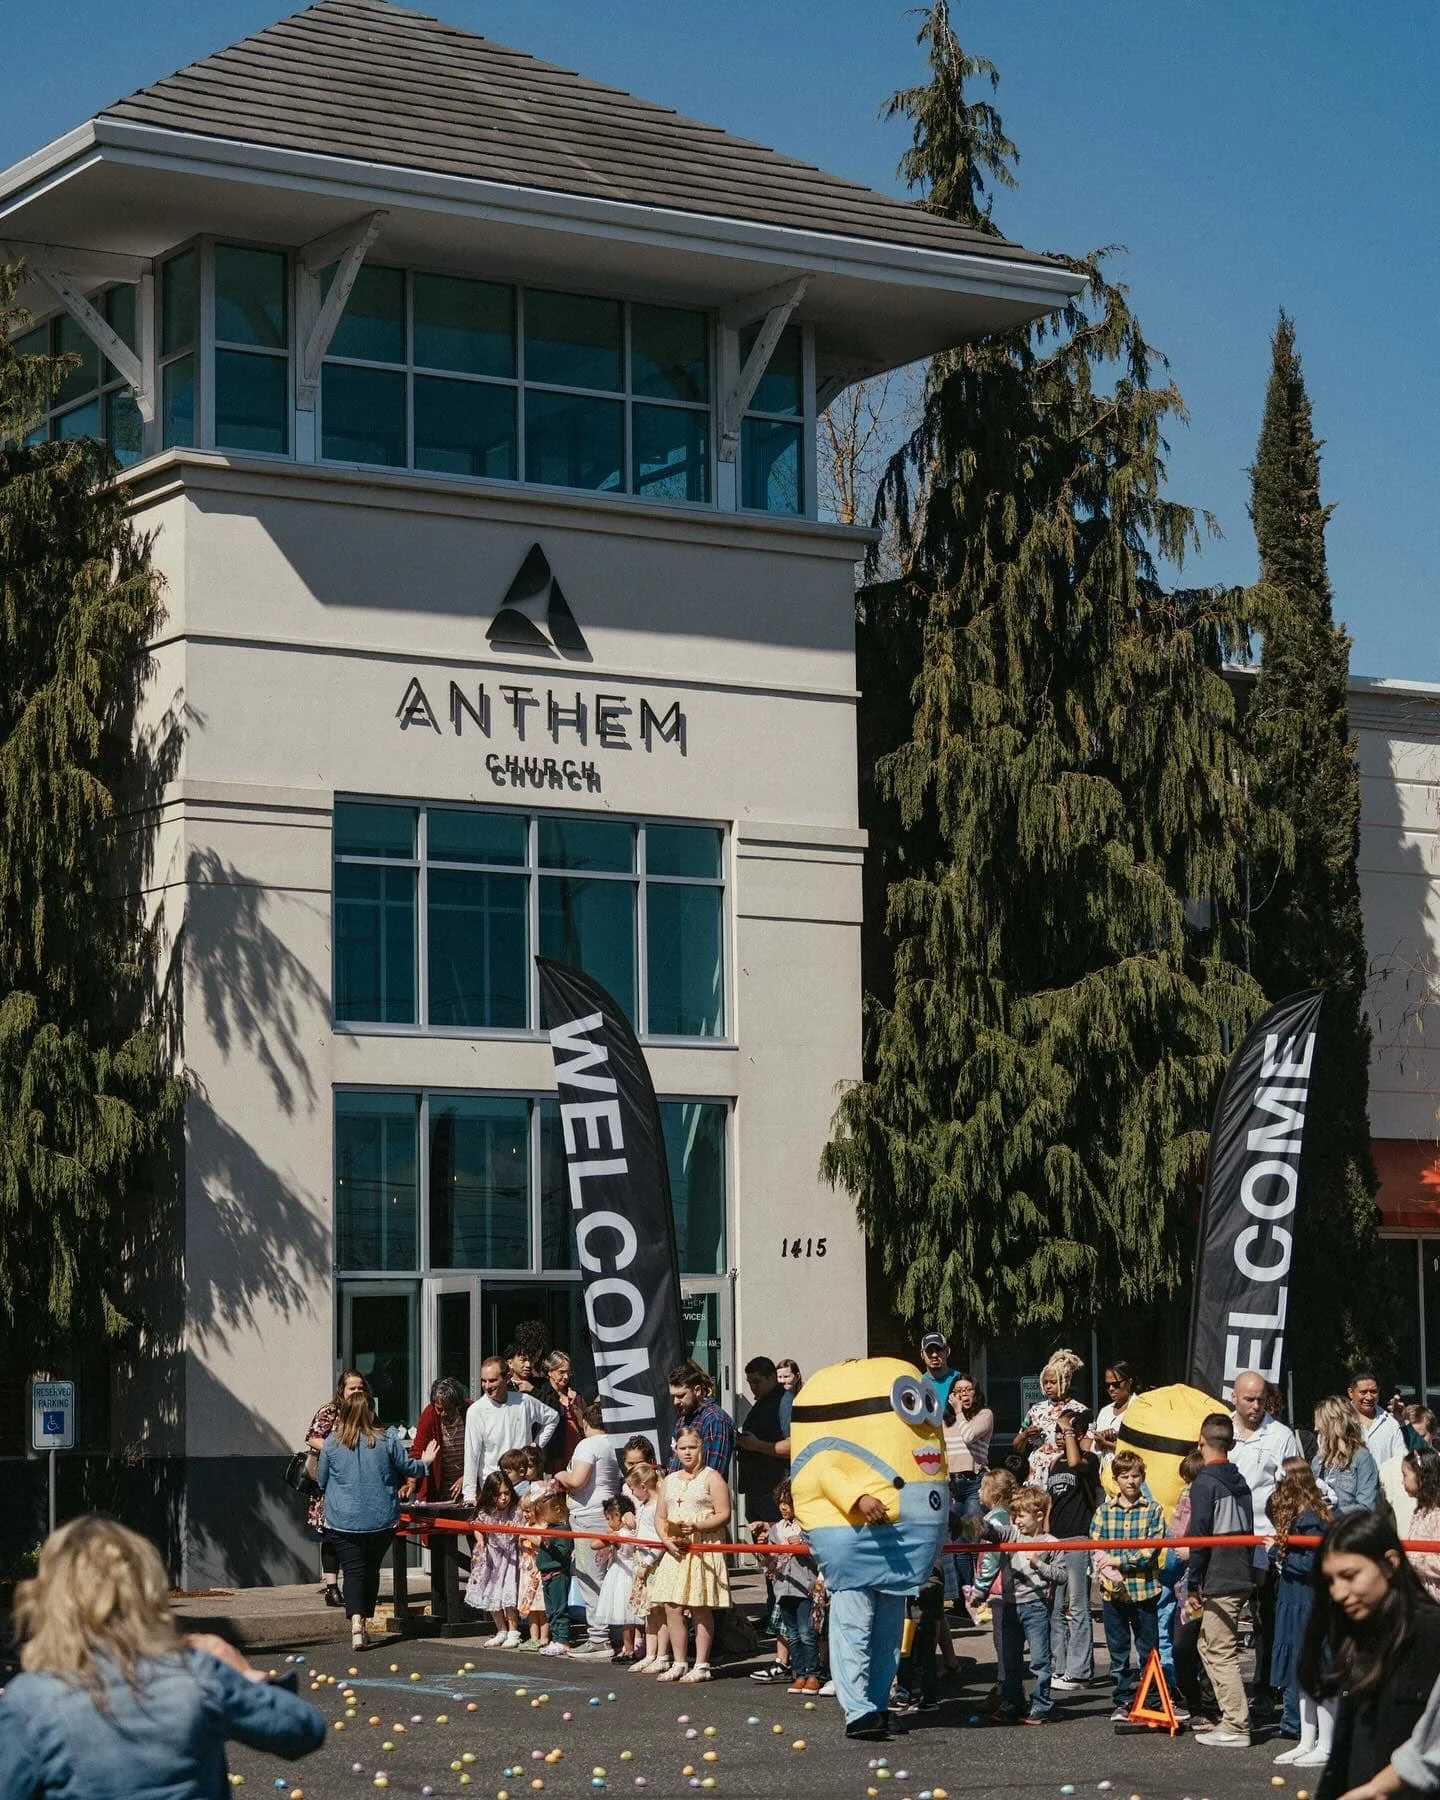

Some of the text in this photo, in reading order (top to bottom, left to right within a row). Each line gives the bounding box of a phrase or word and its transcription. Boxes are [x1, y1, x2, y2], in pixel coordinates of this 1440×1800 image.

[395, 677, 681, 744] ANTHEM
[485, 753, 597, 783] CHURCH
[1222, 1032, 1316, 1402] ELCOME
[781, 1237, 828, 1259] 1415
[36, 1387, 71, 1397] RESERVED
[38, 1399, 69, 1408] PARKING
